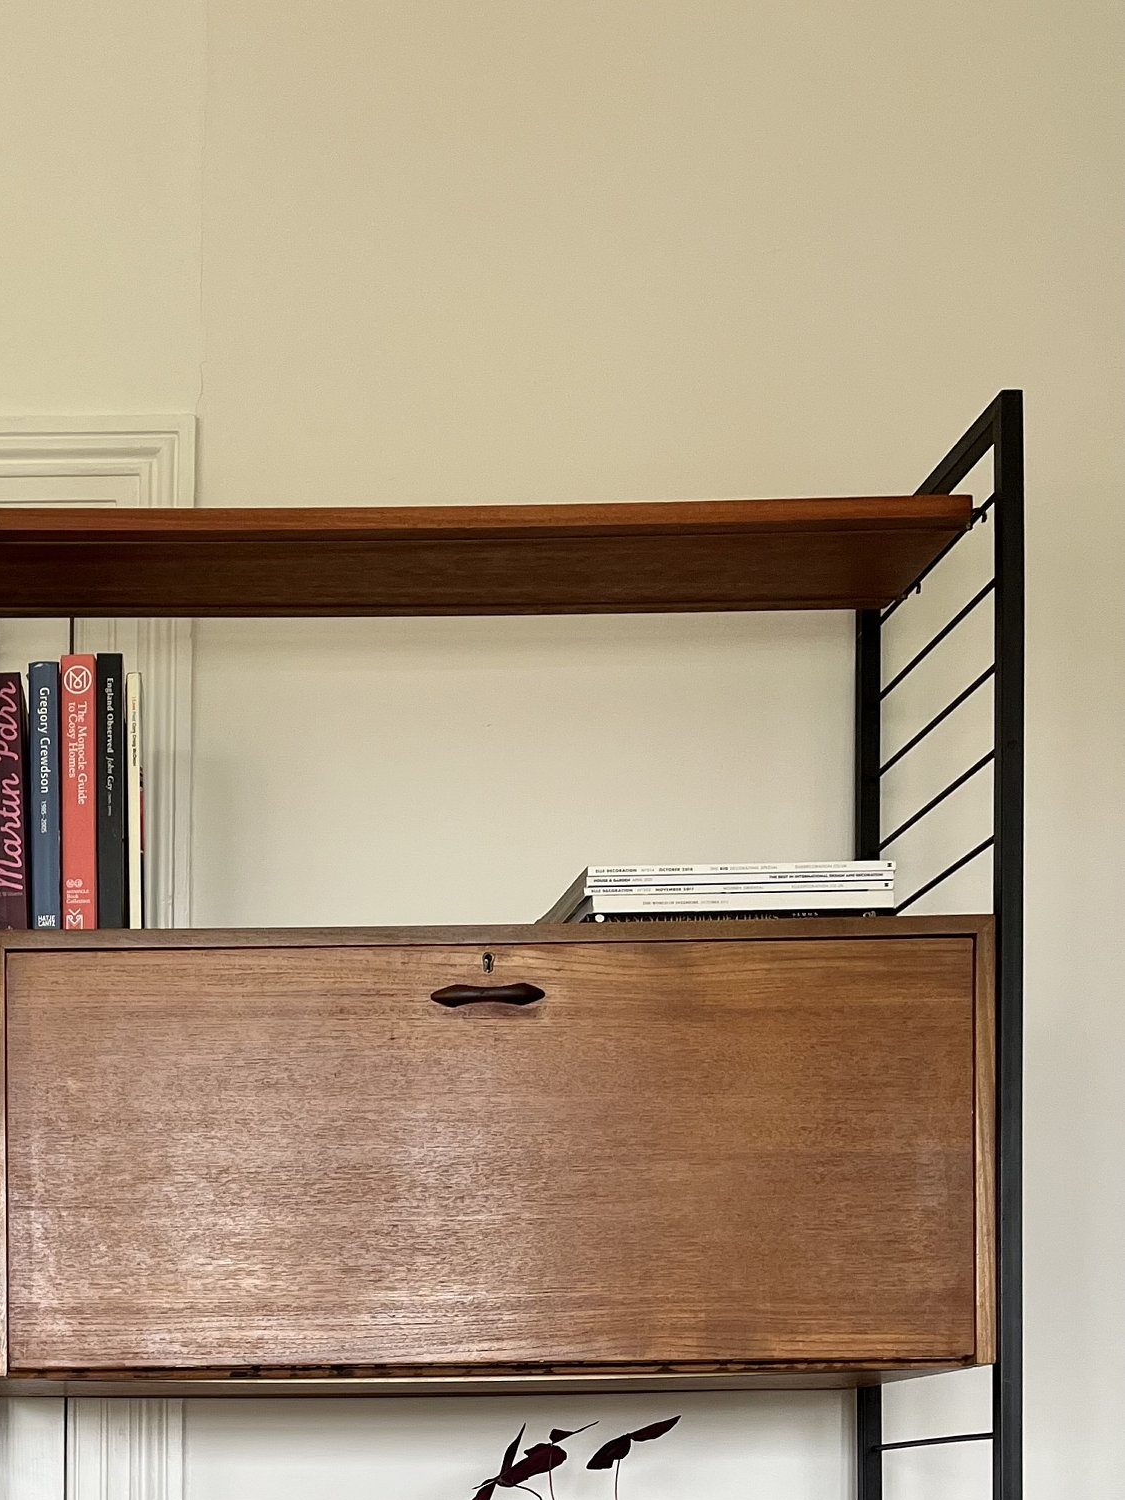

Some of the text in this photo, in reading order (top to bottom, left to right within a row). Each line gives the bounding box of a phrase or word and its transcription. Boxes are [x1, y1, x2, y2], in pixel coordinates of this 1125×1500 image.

[36, 687, 51, 733] Gregory
[104, 677, 114, 711] England
[66, 702, 77, 779] to Cosy Homes
[77, 701, 88, 805] The Monocle Guide
[106, 713, 114, 753] Observed
[39, 737, 52, 794] Crewdson
[105, 756, 114, 775] John
[105, 775, 114, 791] Gay
